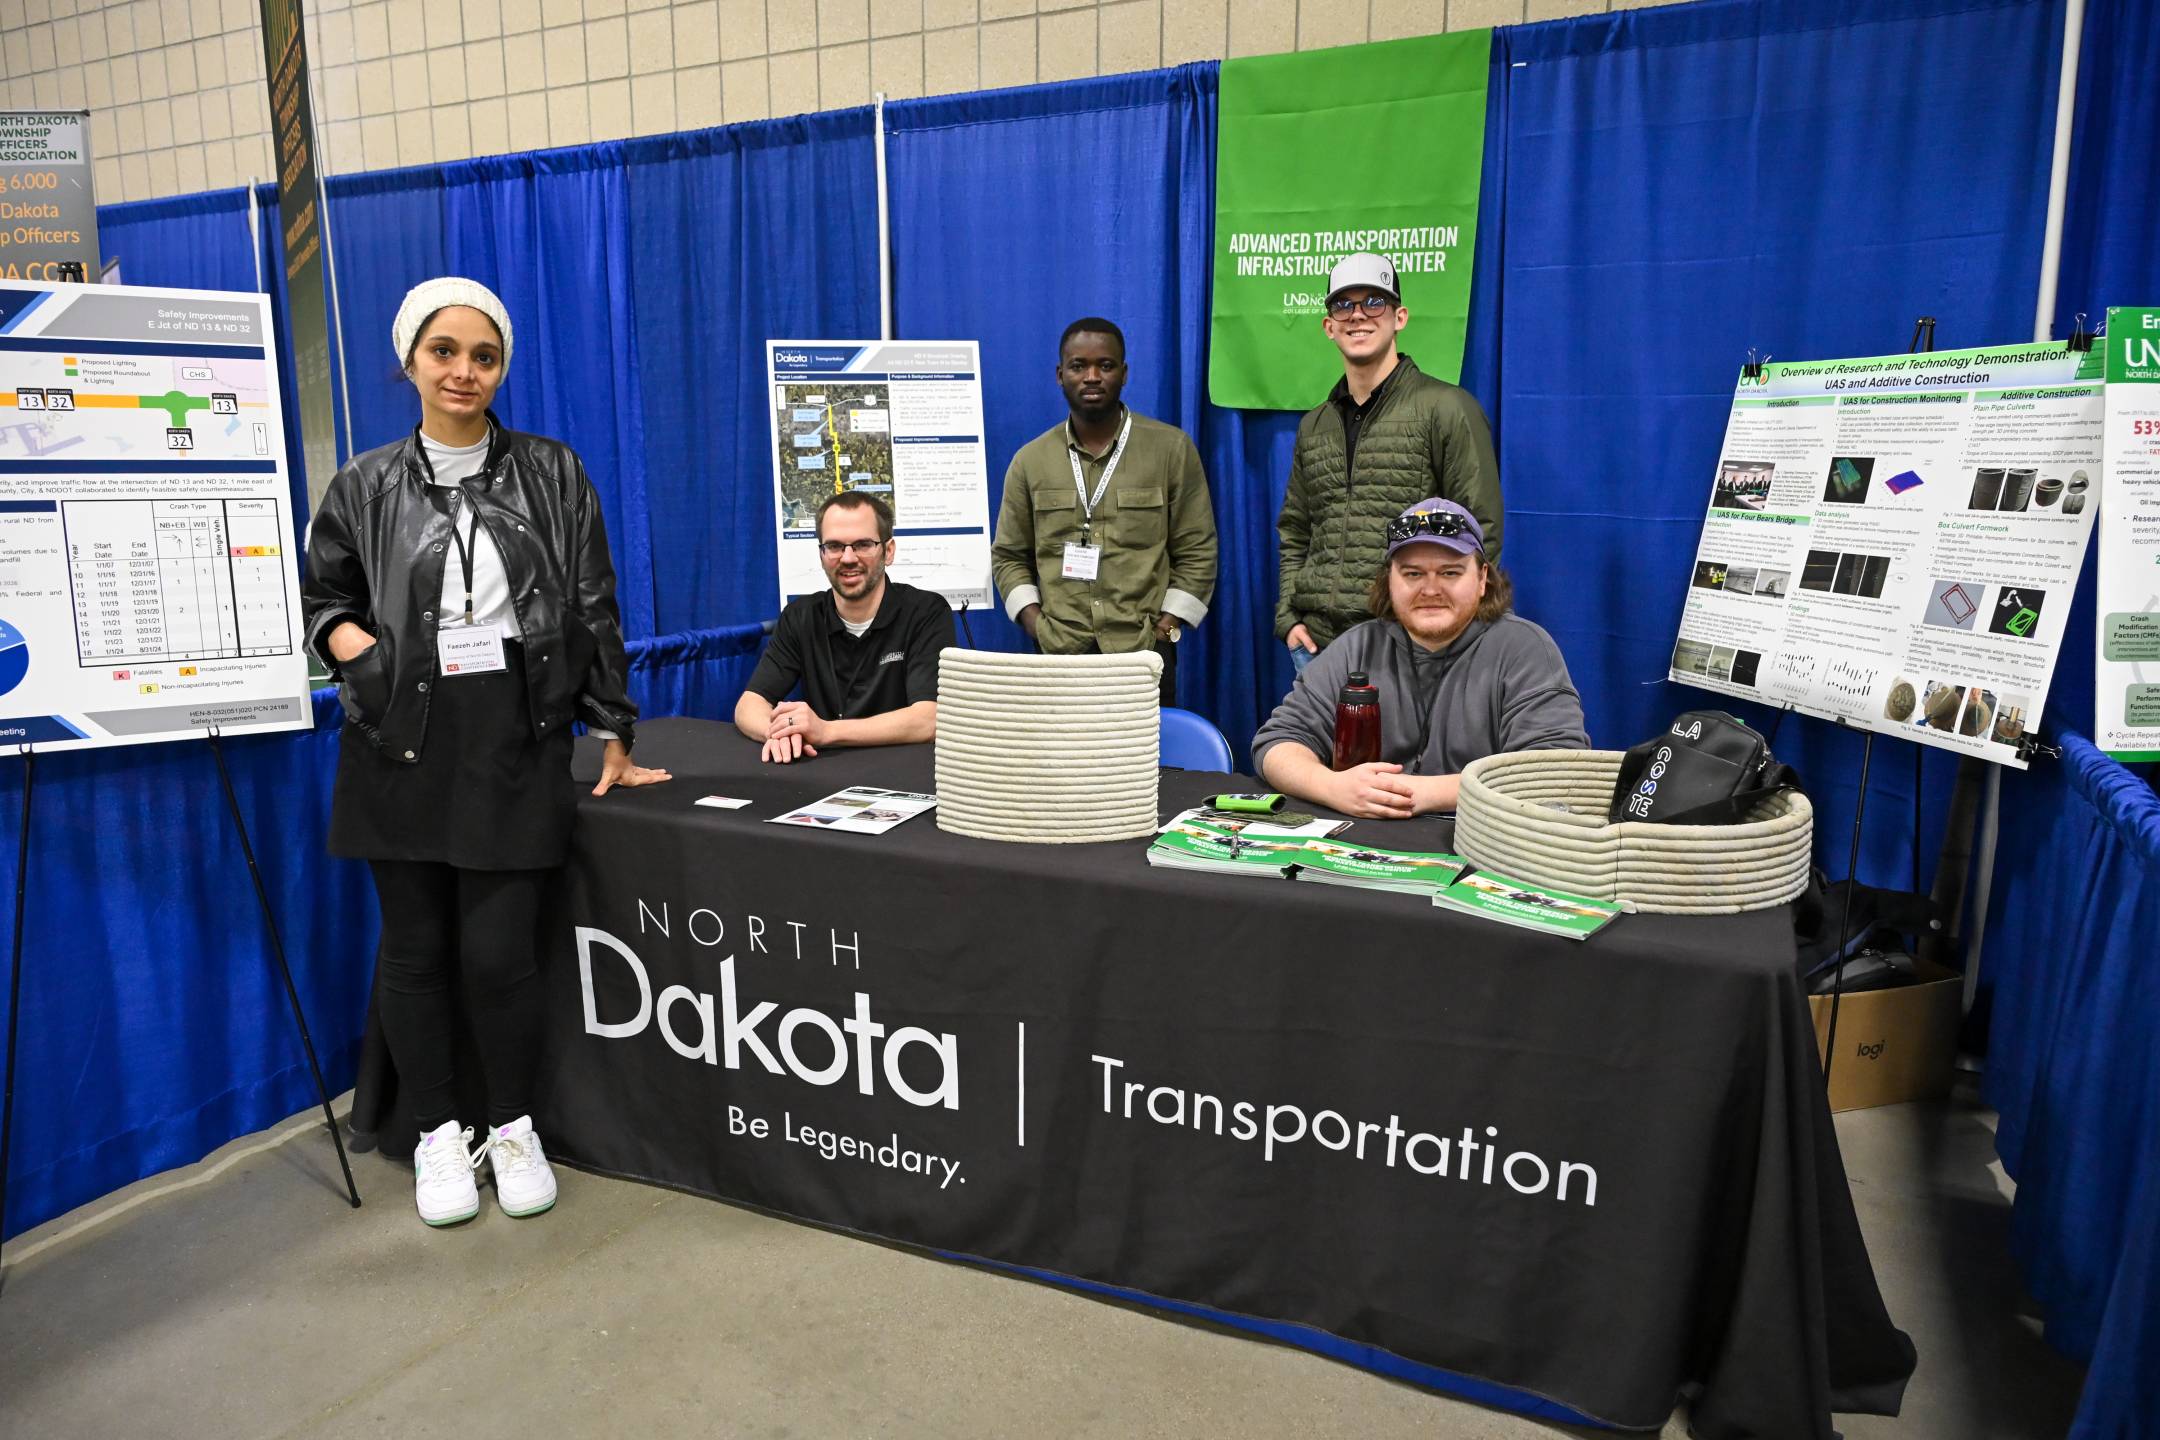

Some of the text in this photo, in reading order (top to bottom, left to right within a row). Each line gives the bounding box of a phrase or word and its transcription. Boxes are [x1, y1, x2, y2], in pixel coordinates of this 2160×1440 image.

[27, 115, 79, 126] DAKOTA
[0, 127, 52, 138] WNSHIP
[10, 171, 57, 191] 6,000
[0, 202, 60, 219] Dakota
[13, 227, 80, 244] Officers
[1229, 226, 1458, 254] ADVANCED TRANSPORTATION
[1283, 293, 1310, 306] UND
[157, 309, 250, 322] Safety Improvements
[148, 320, 251, 334] E Jct of ND 13 & ND 32
[81, 359, 111, 367] Proposed
[775, 353, 808, 363] Dakota
[1781, 367, 1822, 377] Overview
[1825, 366, 1836, 375] of
[1837, 363, 1883, 374] Research
[1885, 361, 1905, 371] and
[1908, 356, 1972, 370] Technology
[82, 369, 112, 377] Proposed
[1824, 372, 1990, 390] UAS and Additive Construction
[1843, 394, 1962, 405] UAS for Construction Monitoring
[2000, 388, 2091, 401] Additive Construction
[23, 396, 39, 408] 13
[51, 396, 69, 408] 32
[216, 400, 231, 412] 13
[1767, 400, 1800, 408] Introduction
[1991, 404, 2005, 413] Pipe
[2007, 403, 2035, 411] Culverts
[171, 436, 188, 447] 32
[2122, 479, 2141, 487] heavy
[192, 503, 207, 511] Type
[1717, 511, 1730, 519] UAS
[1741, 513, 1756, 521] Four
[1757, 514, 1775, 523] Bears
[1775, 516, 1797, 525] Bridge
[1938, 521, 2009, 533] Box Culvert Formwork
[200, 664, 243, 673] Incapacitating
[146, 685, 153, 693] B
[161, 681, 220, 691] Non-incapacitating
[190, 714, 256, 725] Safety Improvements
[2115, 731, 2136, 739] Cycle
[638, 898, 860, 970] NORTH
[1857, 1040, 1885, 1060] logi
[574, 925, 1598, 1206] Dakota Transportation
[728, 1105, 966, 1190] Be Legendary.
